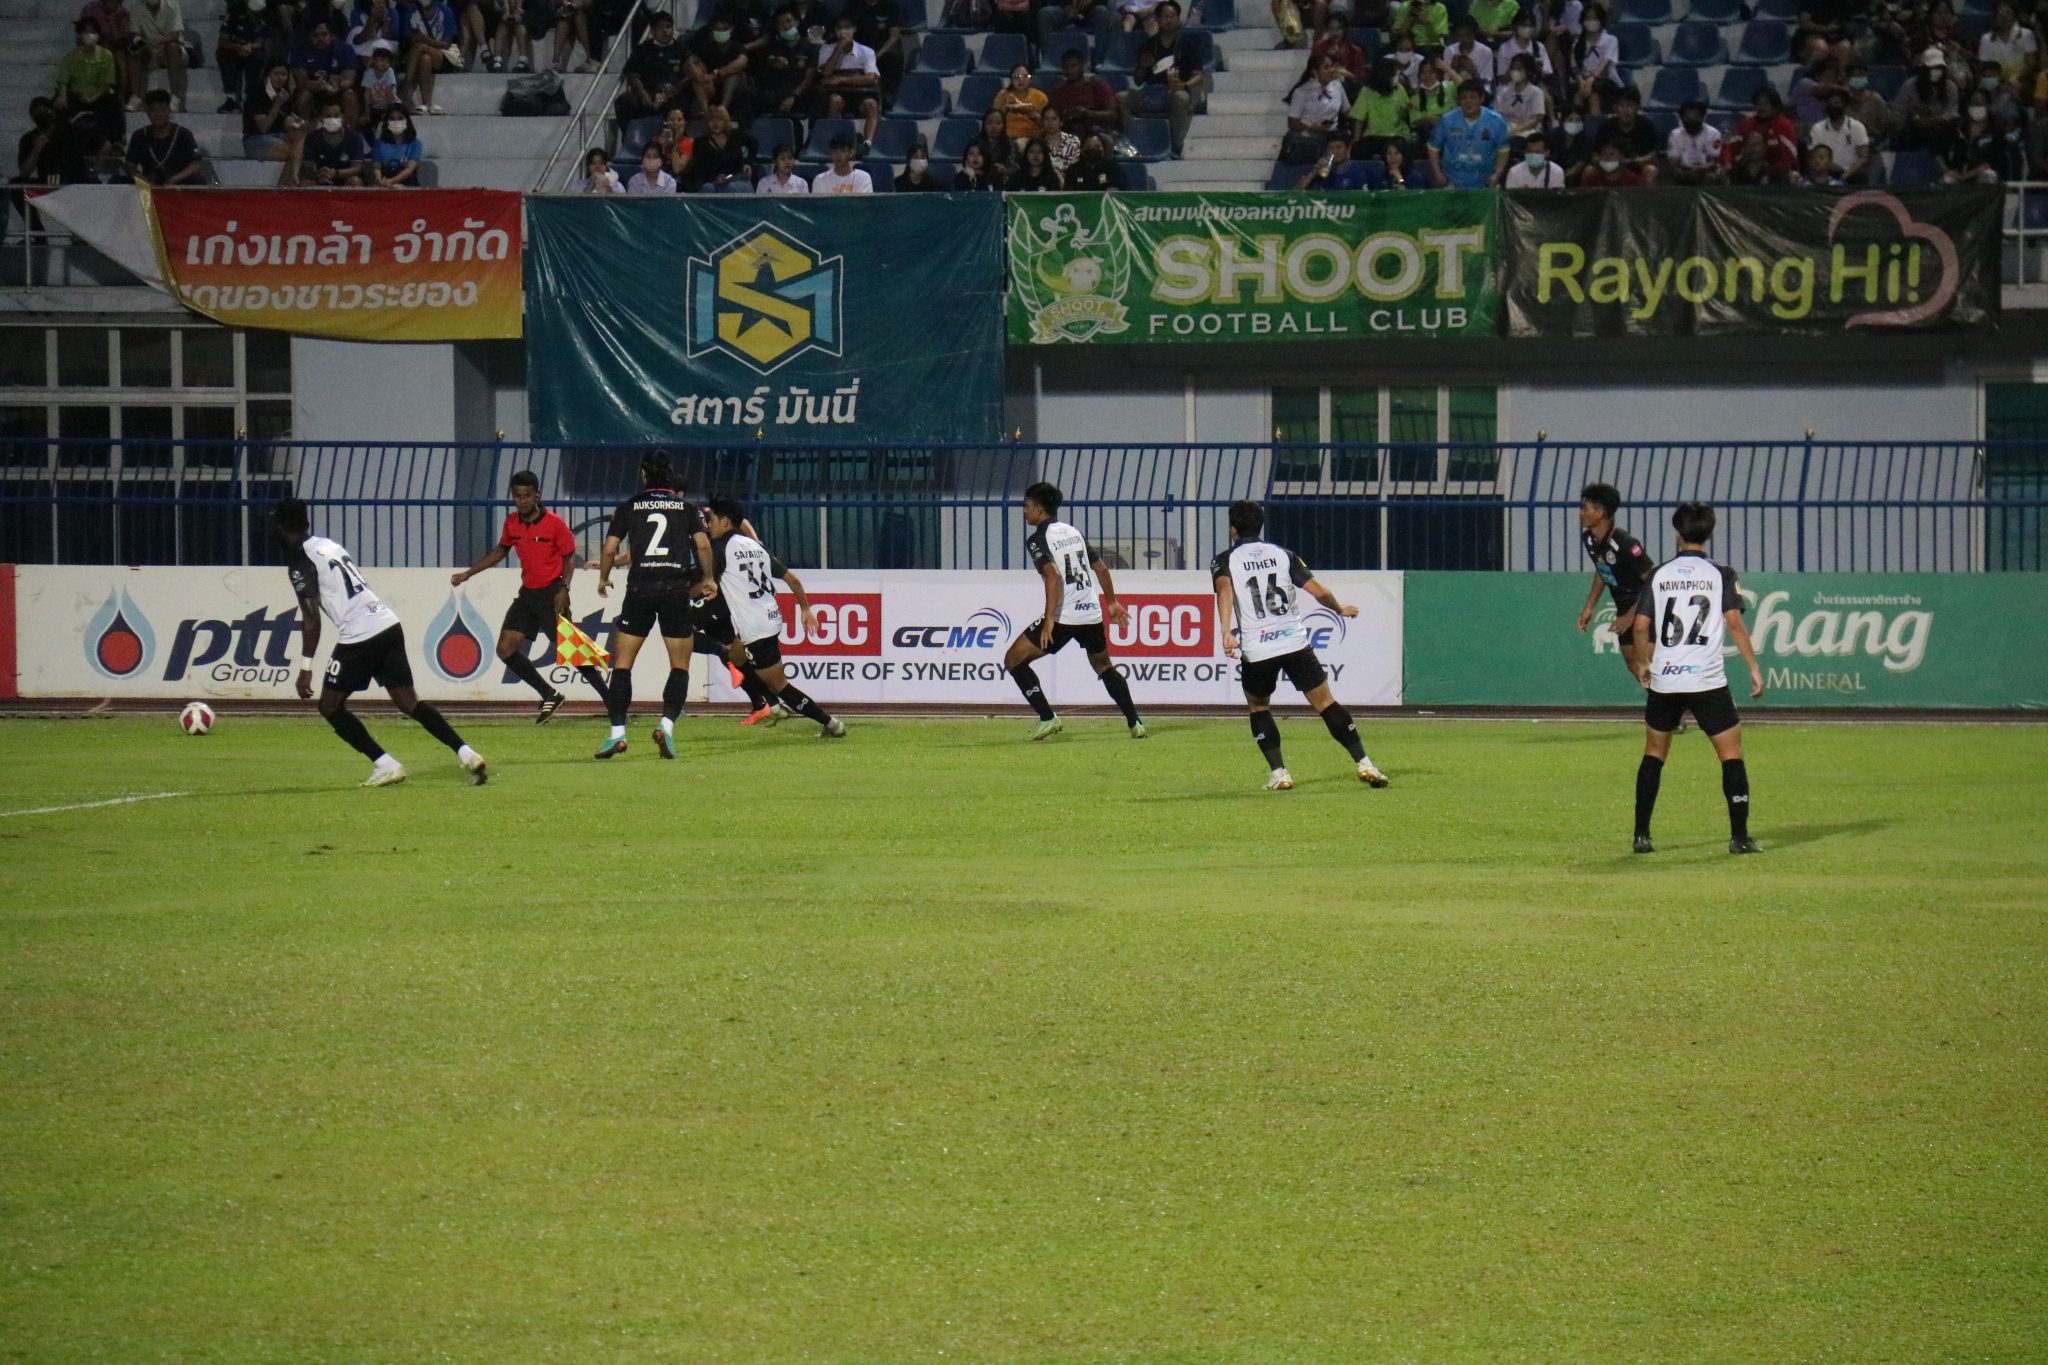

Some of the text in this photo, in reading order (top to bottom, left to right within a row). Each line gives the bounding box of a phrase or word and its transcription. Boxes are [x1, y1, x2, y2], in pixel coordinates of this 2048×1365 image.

[186, 217, 509, 266] เก่งเกล้า จำกัด
[1150, 229, 1485, 305] SHOOT
[1537, 242, 1921, 320] Rayong Hi!
[1149, 307, 1467, 335] FOOTBALL CLUB
[671, 378, 861, 425] สตาร์ มันนี่
[645, 513, 669, 556] 2
[1243, 558, 1277, 571] UTHEN
[1659, 580, 1713, 592] NAWAPHON
[1245, 573, 1289, 620] 16
[778, 603, 868, 646] JGC
[892, 627, 998, 648] GCME
[1109, 604, 1201, 647] JGC
[1661, 594, 1711, 648] 62
[162, 605, 303, 681] ptt
[211, 663, 290, 687] Group
[783, 662, 1006, 681] OWER OF SYNERGY
[1194, 663, 1228, 682] OF
